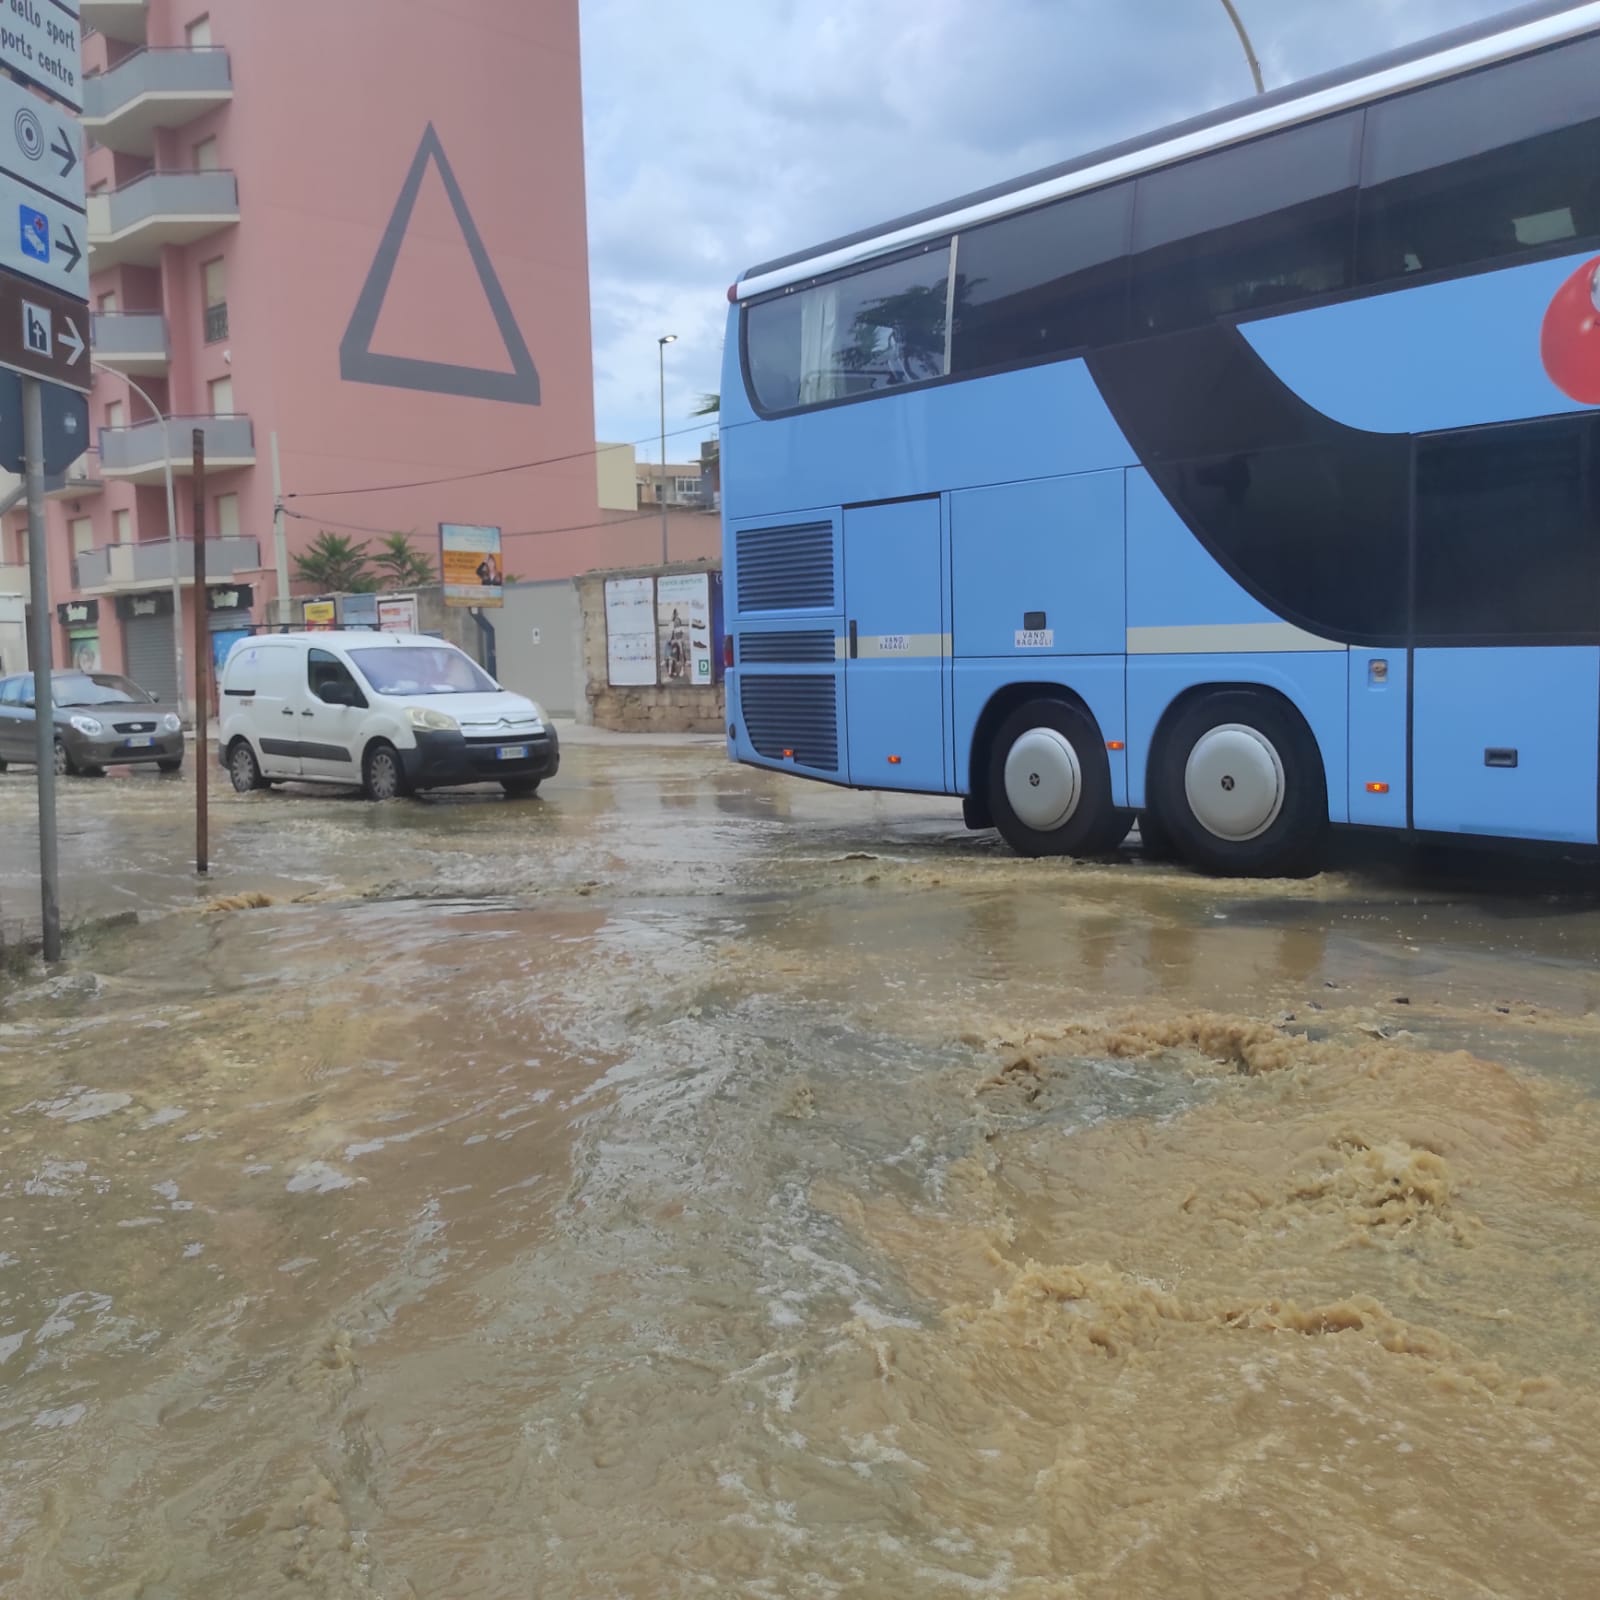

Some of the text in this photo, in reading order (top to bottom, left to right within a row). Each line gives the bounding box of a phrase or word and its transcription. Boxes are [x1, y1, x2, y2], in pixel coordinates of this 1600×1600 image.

[46, 20, 75, 52] sport
[38, 52, 74, 87] centre
[1022, 631, 1045, 639] VANO
